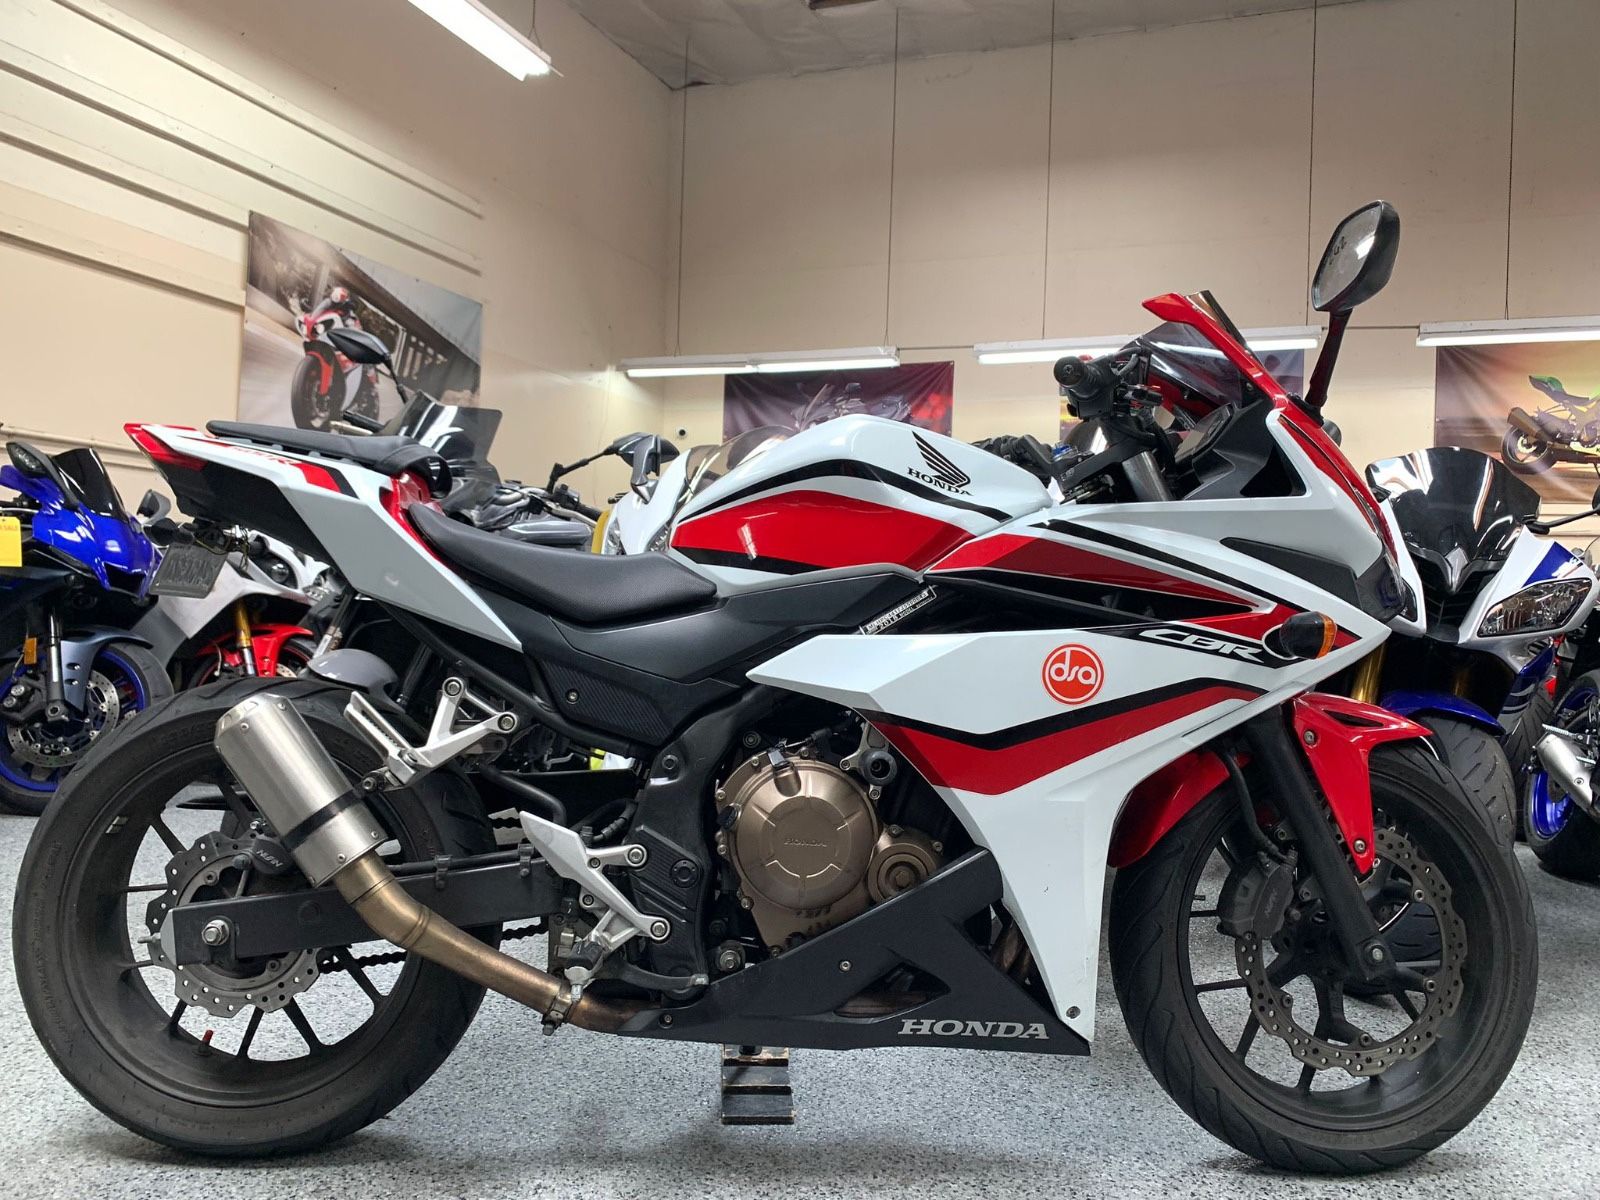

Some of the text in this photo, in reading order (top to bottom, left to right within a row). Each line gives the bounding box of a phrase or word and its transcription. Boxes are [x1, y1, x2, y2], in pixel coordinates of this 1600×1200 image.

[903, 467, 974, 496] HONDA
[1139, 628, 1264, 663] CBR
[898, 1019, 1050, 1040] HONDA
